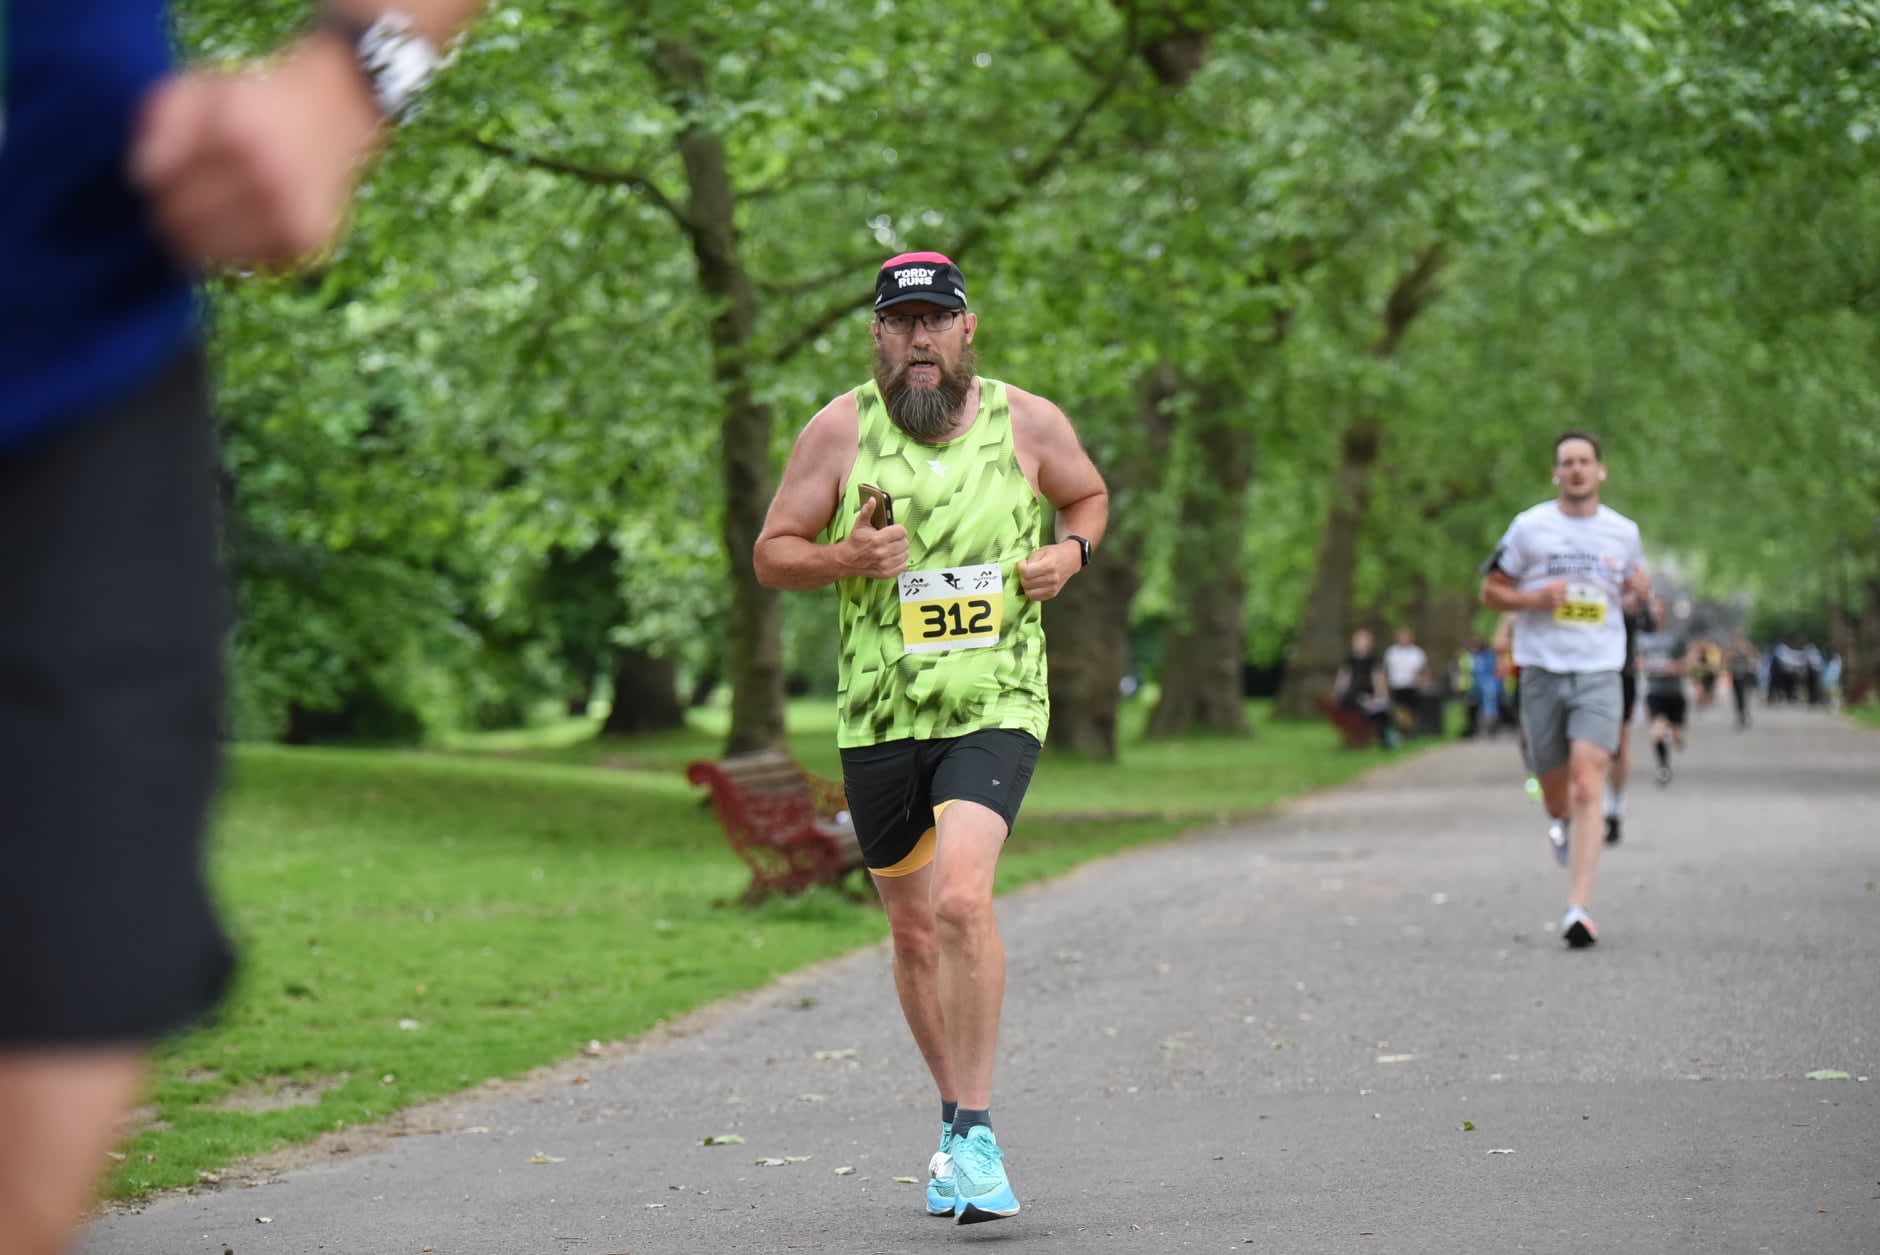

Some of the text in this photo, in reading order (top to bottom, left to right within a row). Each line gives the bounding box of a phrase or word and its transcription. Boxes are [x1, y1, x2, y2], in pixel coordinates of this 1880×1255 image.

[893, 268, 936, 280] FORDY
[898, 276, 933, 288] RUNS
[920, 600, 993, 638] 312
